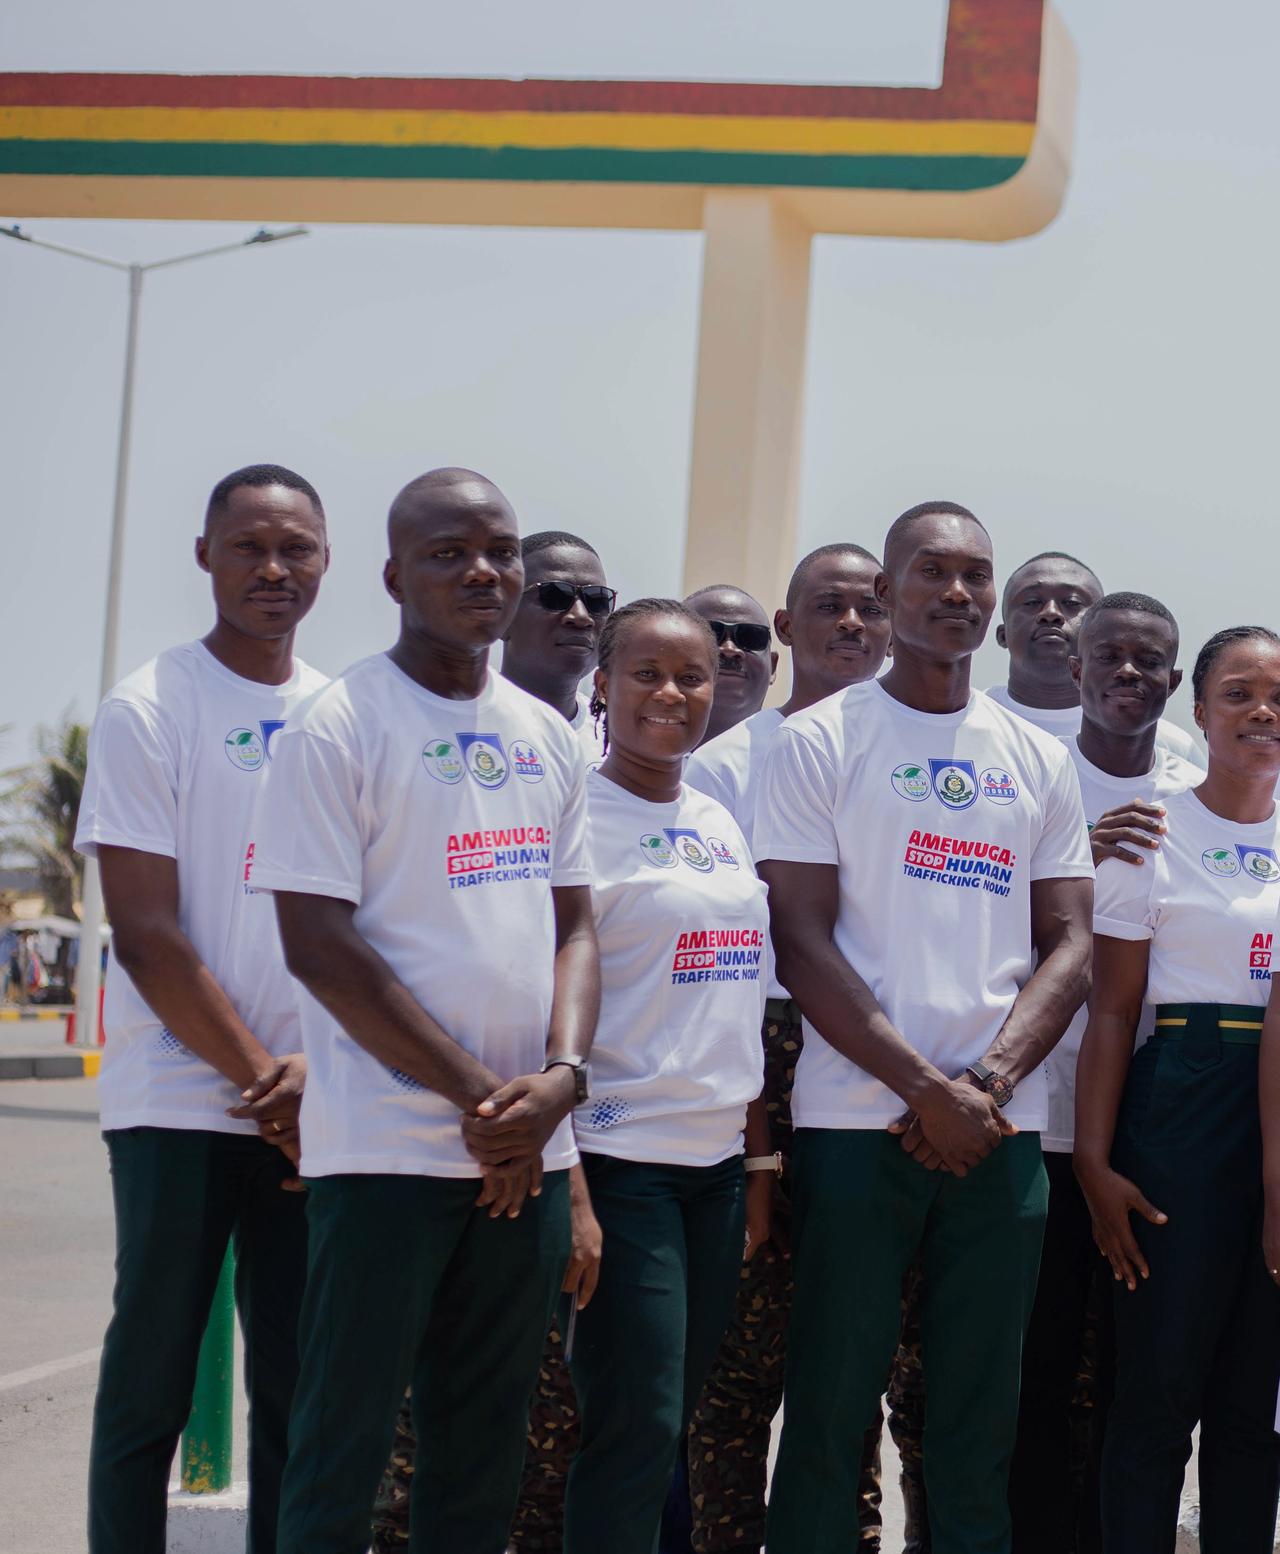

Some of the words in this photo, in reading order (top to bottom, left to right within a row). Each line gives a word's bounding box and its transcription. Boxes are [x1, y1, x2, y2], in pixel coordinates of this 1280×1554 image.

[447, 827, 551, 853] AMEWUGA:
[908, 830, 1016, 867] AMEWUGA:
[451, 854, 492, 872] STOP
[495, 848, 550, 866] HUMAN
[908, 850, 944, 867] STOP
[946, 858, 1013, 883] HUMAN
[449, 867, 531, 889] TRAFFICKING
[904, 864, 980, 888] TRAFFICKING
[983, 880, 1011, 897] NOW!
[676, 930, 763, 950] AMEWUGA:
[677, 953, 715, 968] STOP
[716, 951, 761, 966] HUMAN
[1254, 953, 1271, 966] ST
[672, 969, 740, 985] TRAFFICKING
